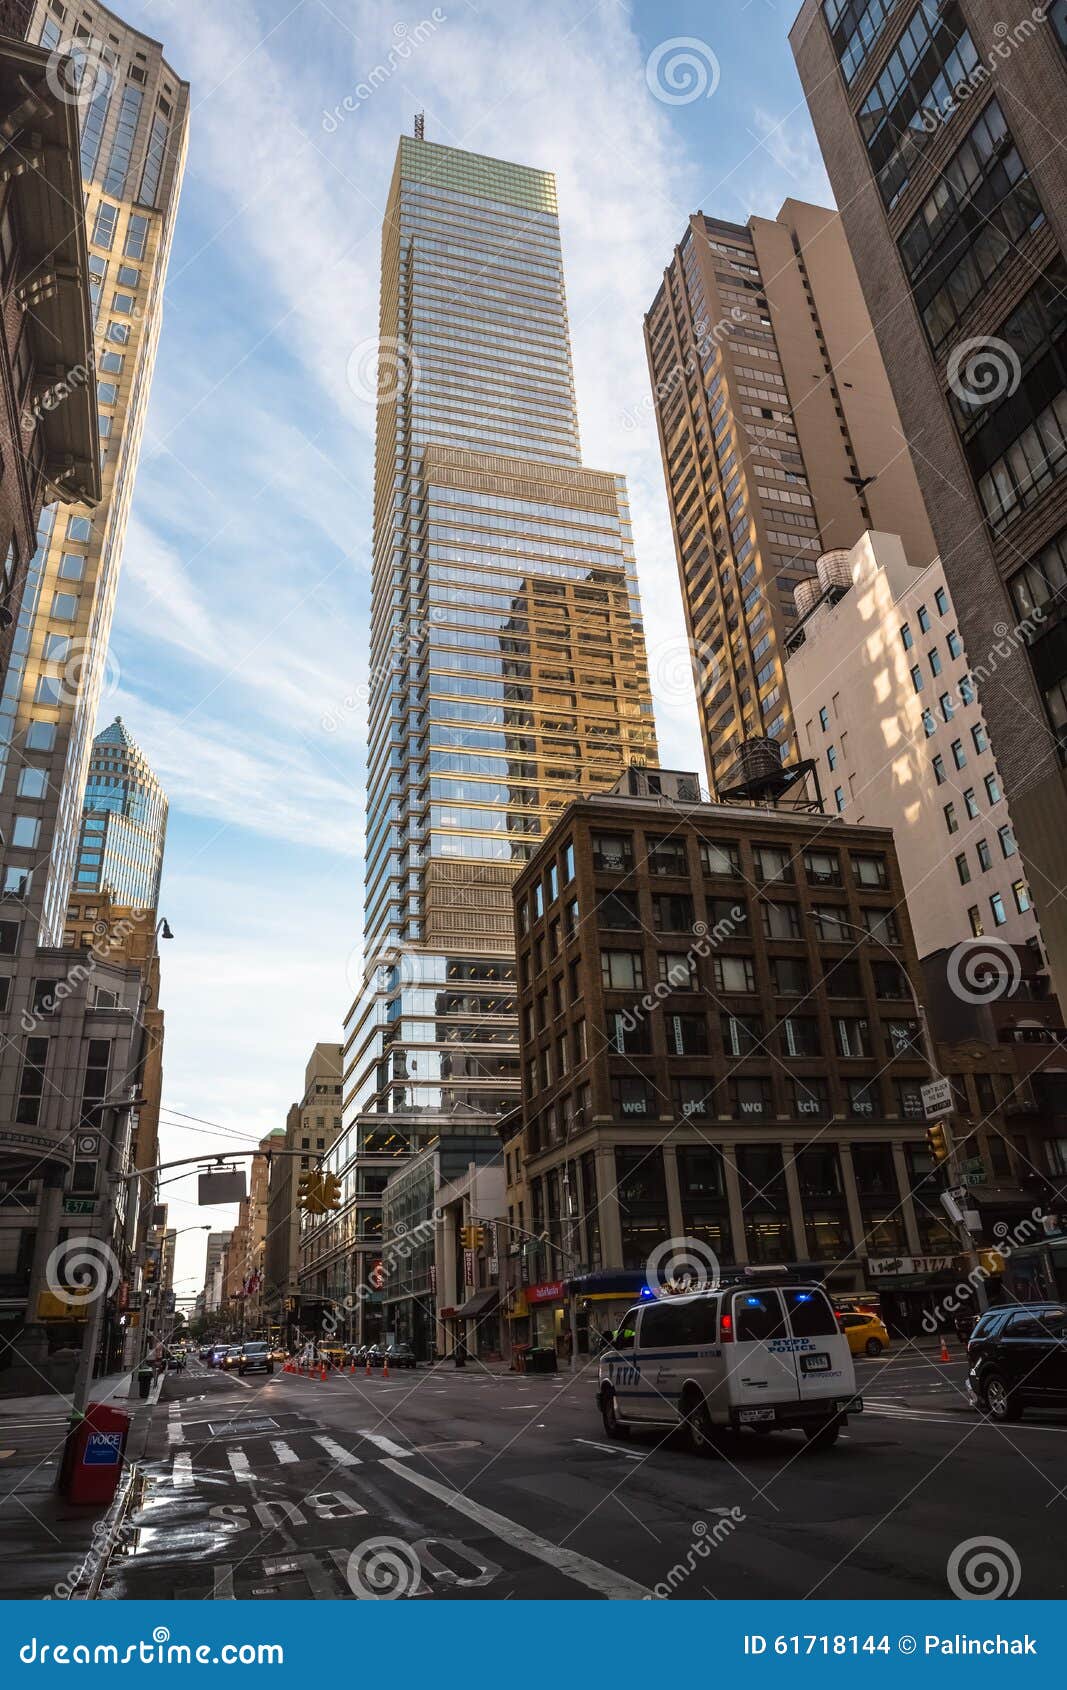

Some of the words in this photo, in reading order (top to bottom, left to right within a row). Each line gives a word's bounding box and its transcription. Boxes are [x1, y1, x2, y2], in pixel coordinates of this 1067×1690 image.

[622, 1099, 647, 1113] wei
[682, 1099, 706, 1117] ght
[741, 1102, 763, 1113] wa
[797, 1099, 820, 1113] tch
[852, 1101, 873, 1112] ers
[772, 1337, 810, 1347] NYPD
[768, 1344, 817, 1354] POLICE
[91, 1434, 121, 1446] VOICE
[208, 1490, 369, 1534] BUS
